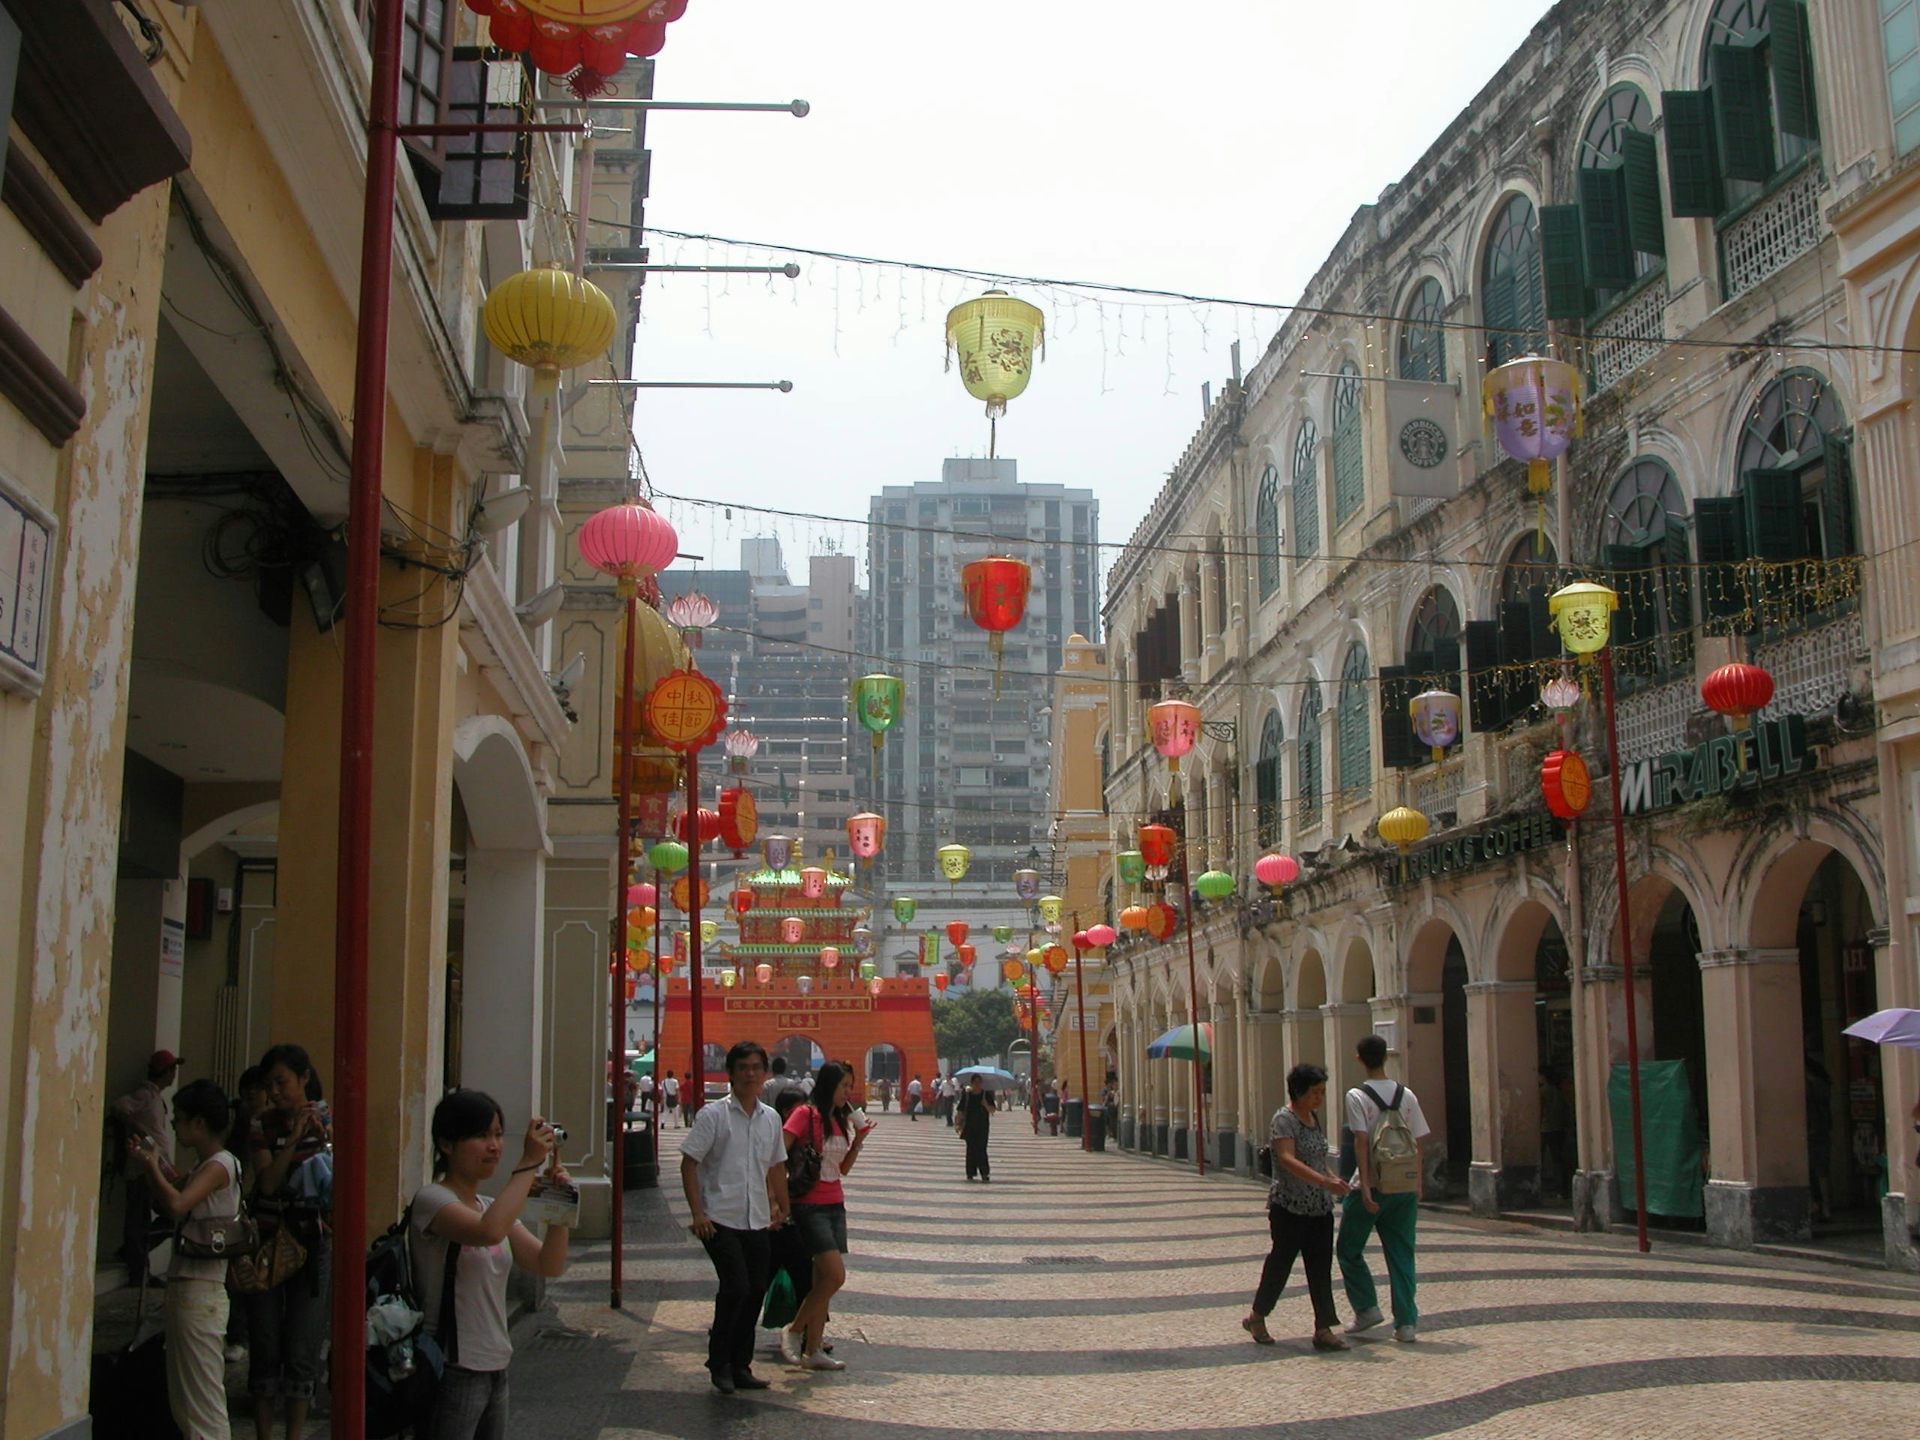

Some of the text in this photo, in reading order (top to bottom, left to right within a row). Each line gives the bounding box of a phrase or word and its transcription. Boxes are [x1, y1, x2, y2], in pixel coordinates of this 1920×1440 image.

[1514, 403, 1539, 436] 如意
[1402, 420, 1445, 443] STARBUCKS
[1407, 452, 1441, 468] COFFEE
[667, 689, 704, 705] 中秋
[1381, 814, 1553, 883] STRBUCKS COFFEE
